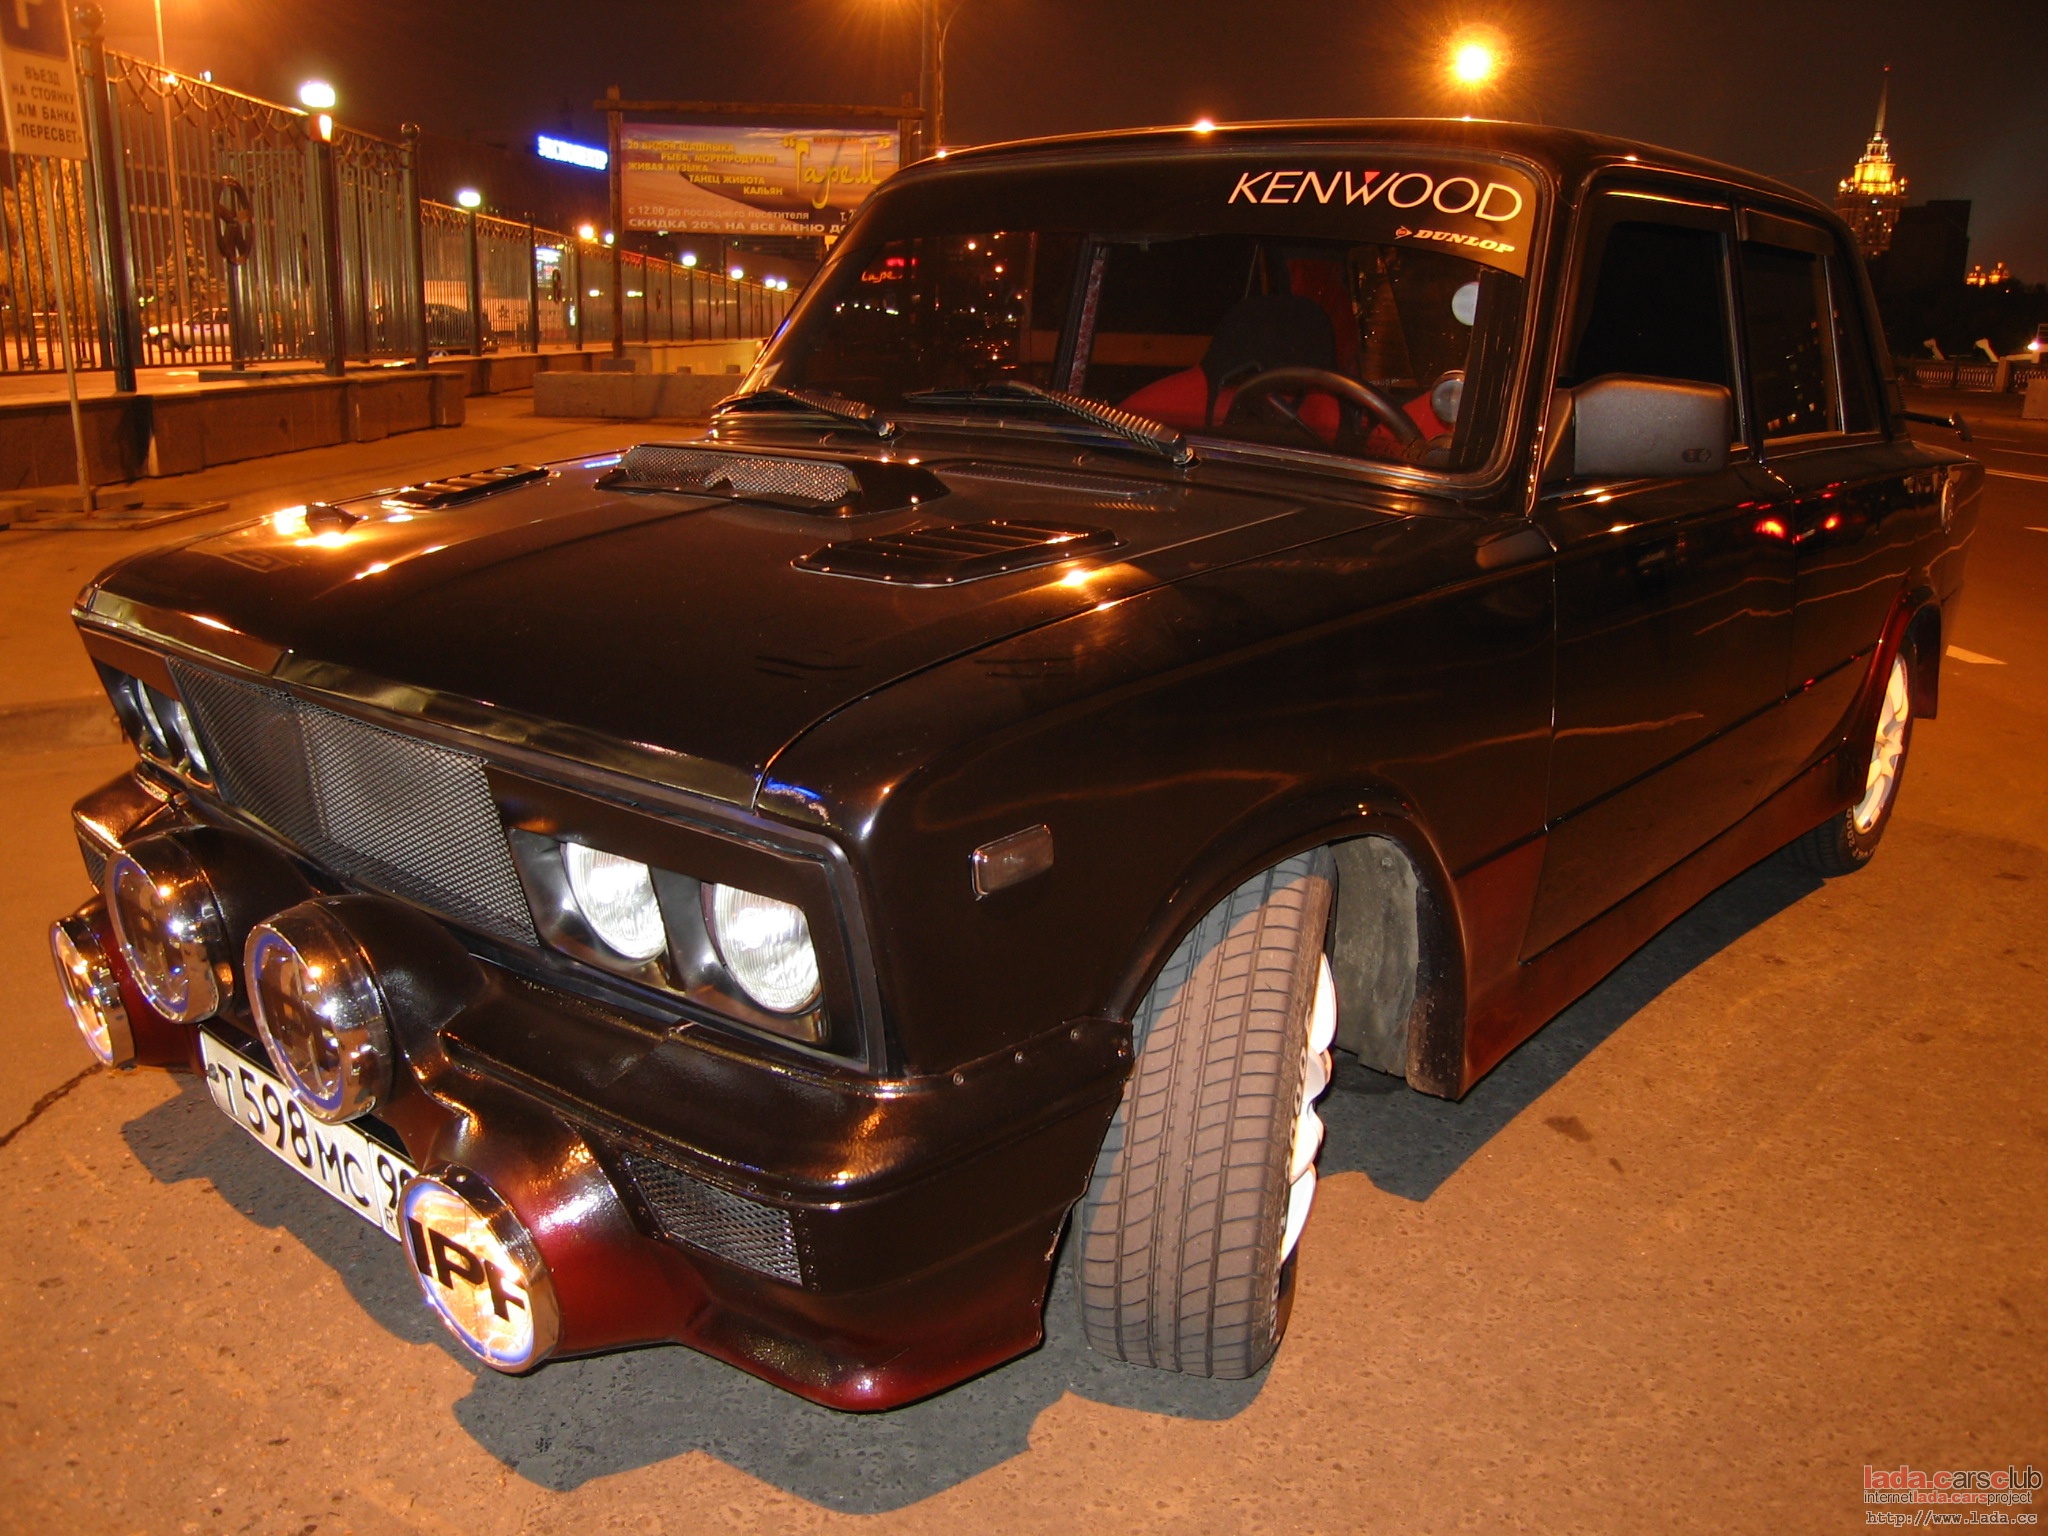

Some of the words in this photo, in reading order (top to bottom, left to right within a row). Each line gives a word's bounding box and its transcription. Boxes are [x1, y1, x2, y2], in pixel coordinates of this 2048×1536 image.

[24, 65, 61, 87] ВЪЕЗД
[11, 83, 27, 97] НА
[30, 84, 74, 105] СТОЯНКУ
[16, 102, 37, 119] А/М
[42, 106, 77, 125] БАНКА
[694, 153, 777, 165] МОРЕПРОДУКТЫ
[627, 162, 665, 172] ЖИВАЯ
[667, 163, 709, 173] МУЗЫКА
[689, 175, 721, 186] ТАНЕЦ
[722, 175, 766, 185] ЖИВОТА
[743, 186, 784, 197] КАЛЬЯН
[1227, 170, 1523, 222] KENWOOD
[667, 207, 681, 218] до
[683, 208, 745, 220] последнего
[747, 209, 810, 220] посетителя
[627, 218, 687, 230] СКИДКА
[691, 219, 720, 231] 20%
[725, 220, 747, 231] НА
[751, 221, 776, 232] ВСЕ
[780, 222, 825, 233] МЕНЮ
[1413, 229, 1516, 254] DUNLOP
